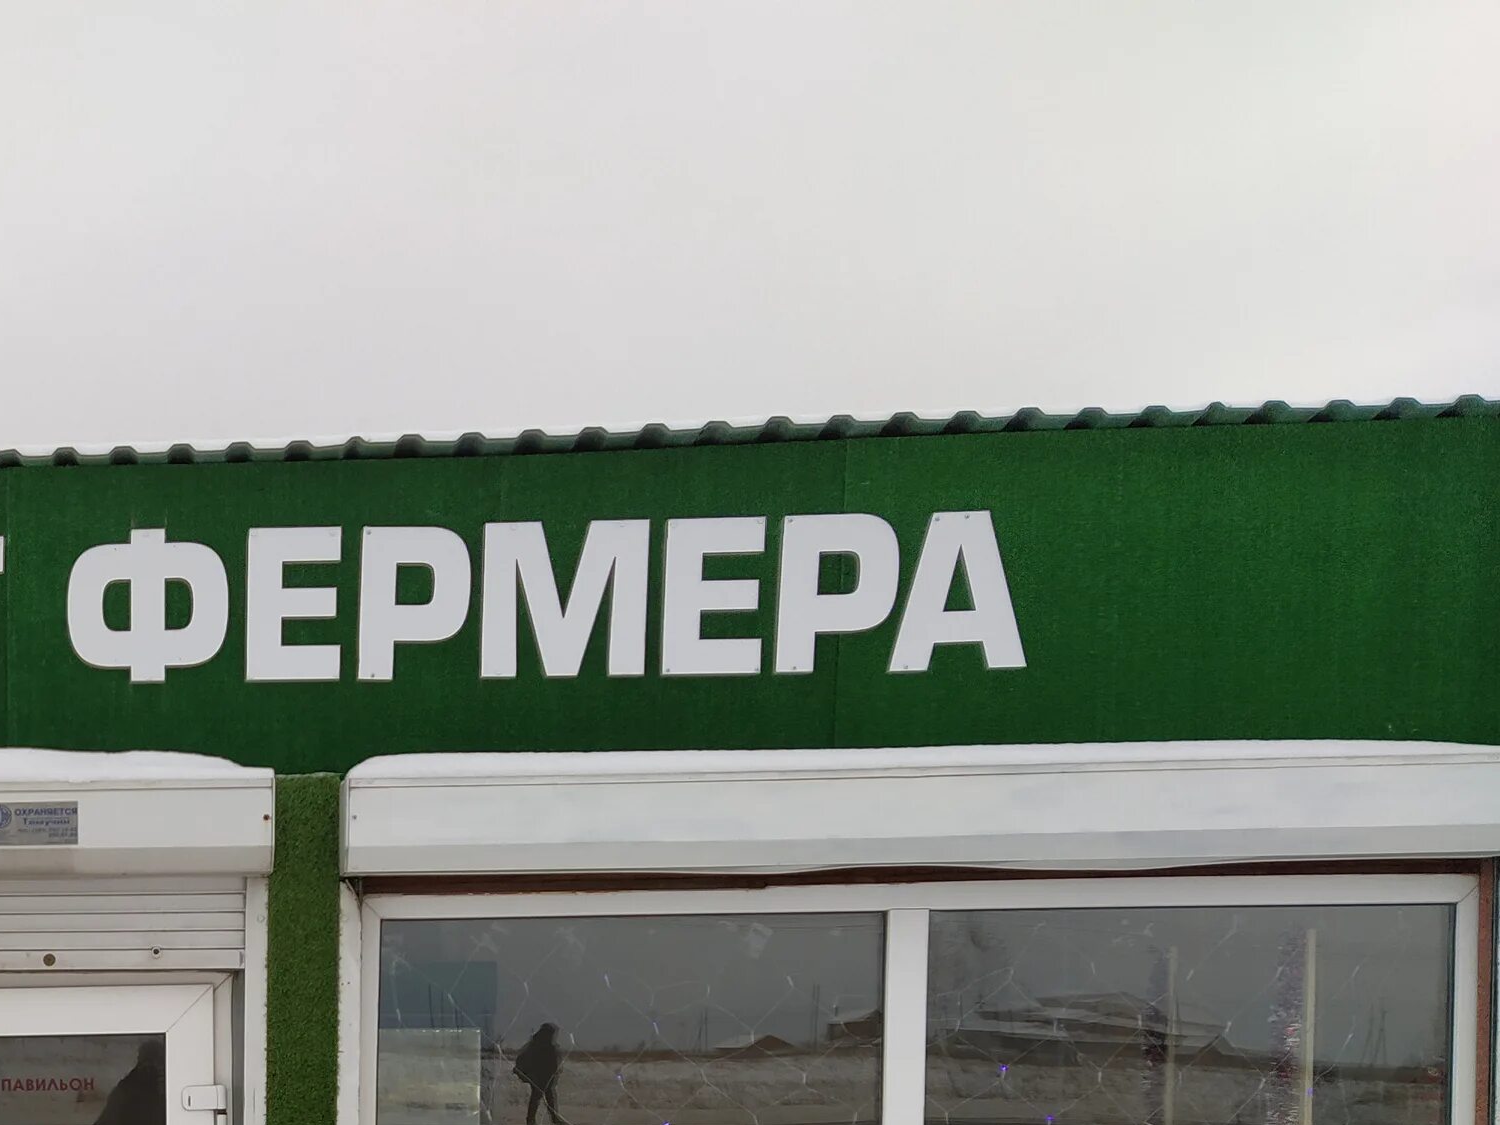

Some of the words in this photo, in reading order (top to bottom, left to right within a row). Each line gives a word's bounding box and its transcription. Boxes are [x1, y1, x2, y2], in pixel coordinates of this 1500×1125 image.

[67, 510, 1027, 683] ФЕРМЕРА
[14, 807, 78, 817] ОХРАНЯЕТСЯ
[0, 1077, 95, 1093] ПАВИЛЬОН
